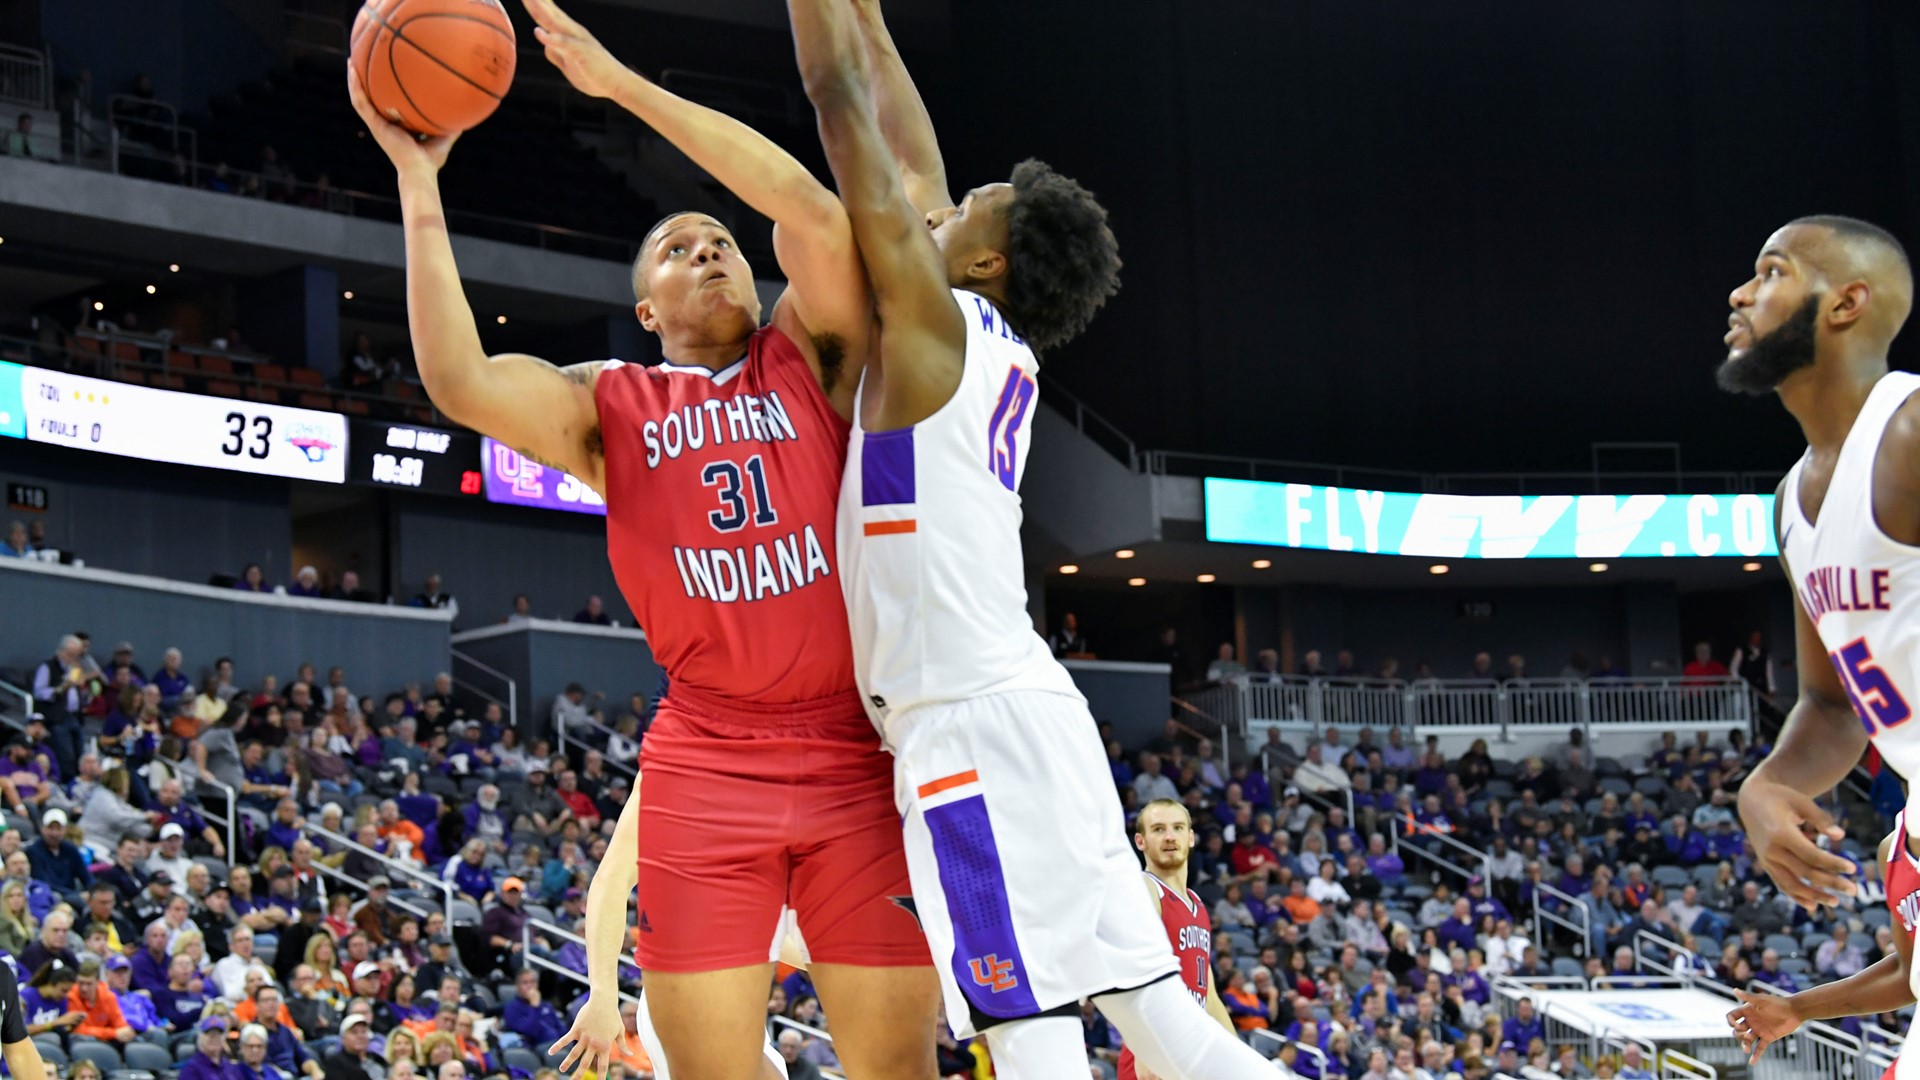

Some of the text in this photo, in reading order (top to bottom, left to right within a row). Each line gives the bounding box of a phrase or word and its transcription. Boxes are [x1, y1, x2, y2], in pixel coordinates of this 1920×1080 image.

[91, 423, 101, 443] 0
[222, 411, 273, 460] 33
[989, 364, 1034, 492] 13
[701, 455, 778, 533] 31
[673, 524, 830, 602] INDIANA
[968, 953, 1016, 993] UE
